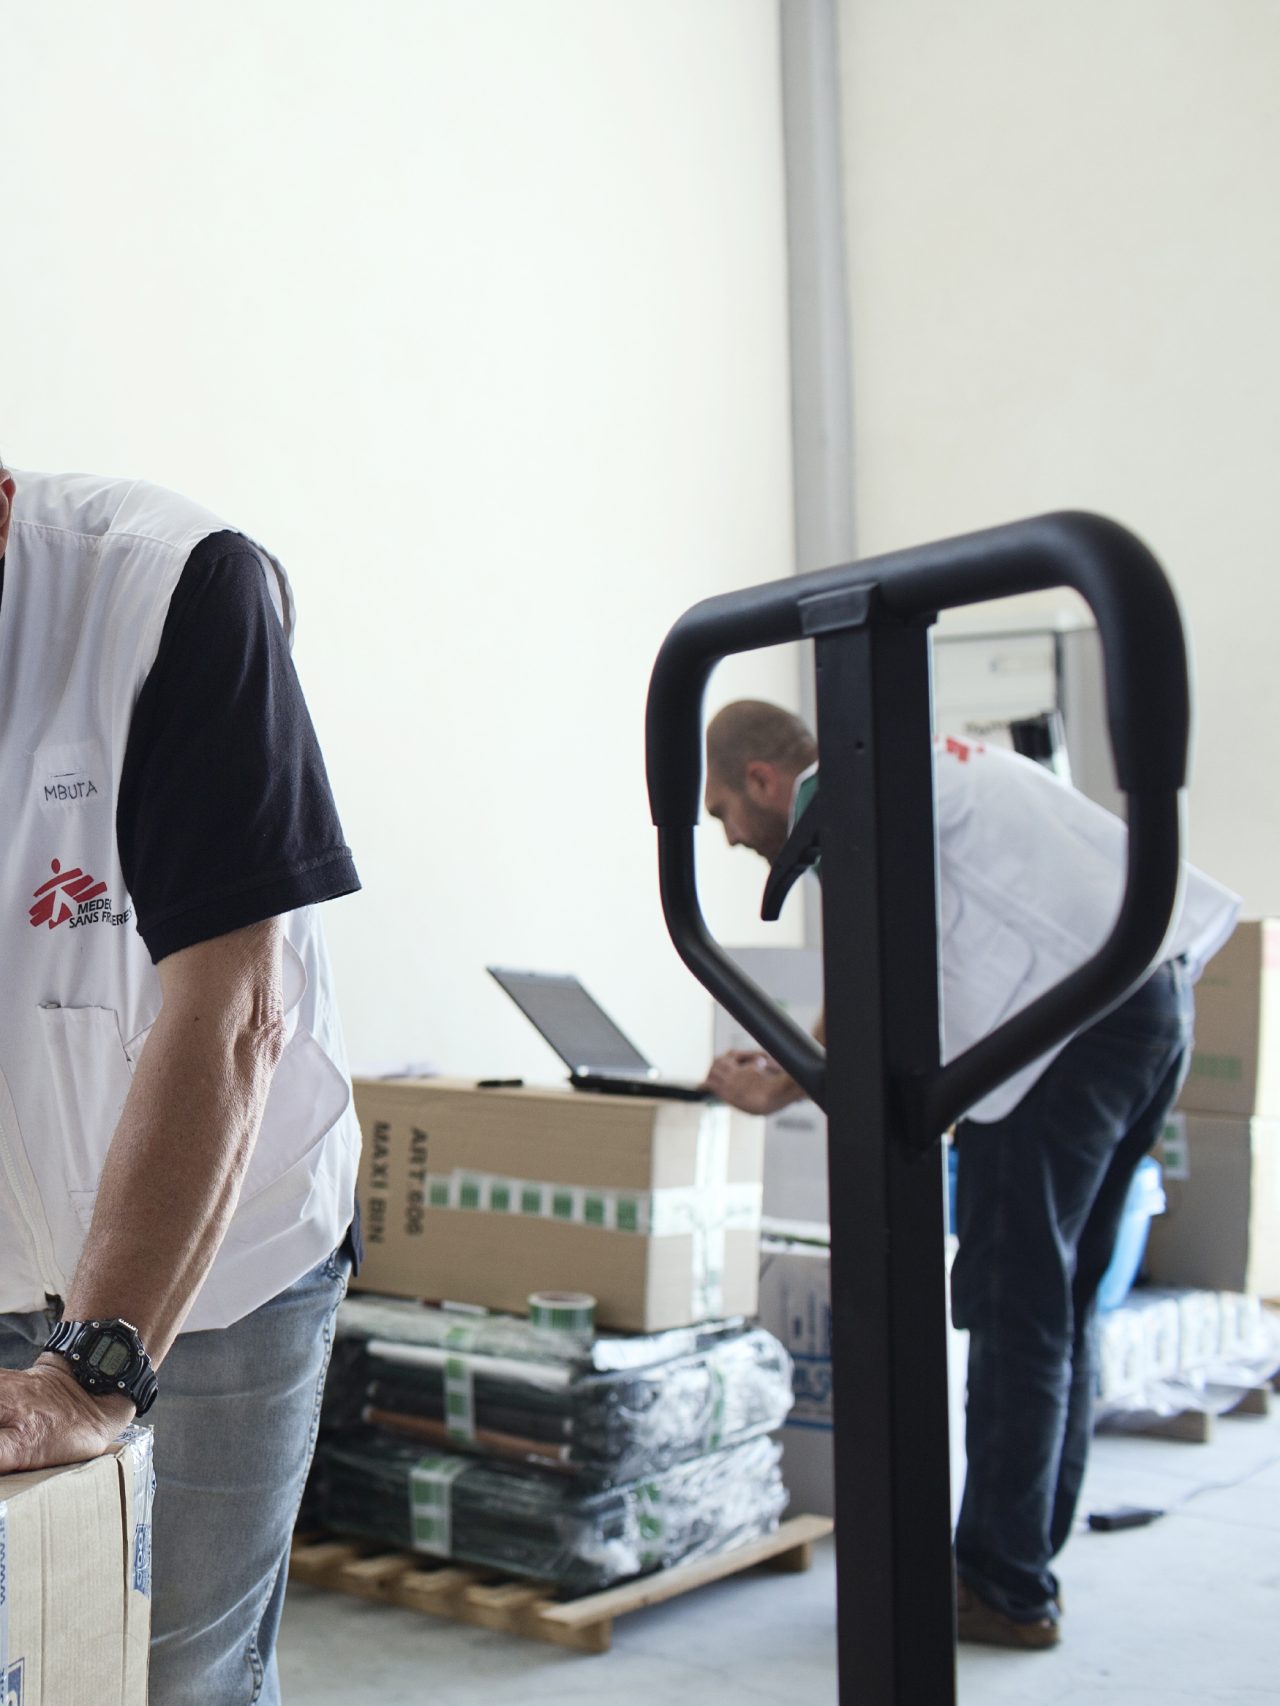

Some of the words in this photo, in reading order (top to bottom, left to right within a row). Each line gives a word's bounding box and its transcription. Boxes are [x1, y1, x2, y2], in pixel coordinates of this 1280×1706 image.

[44, 780, 98, 801] MBUTA
[69, 912, 99, 929] SANS
[370, 1120, 391, 1190] MAXI
[409, 1126, 428, 1182] ART
[368, 1197, 387, 1244] BIN
